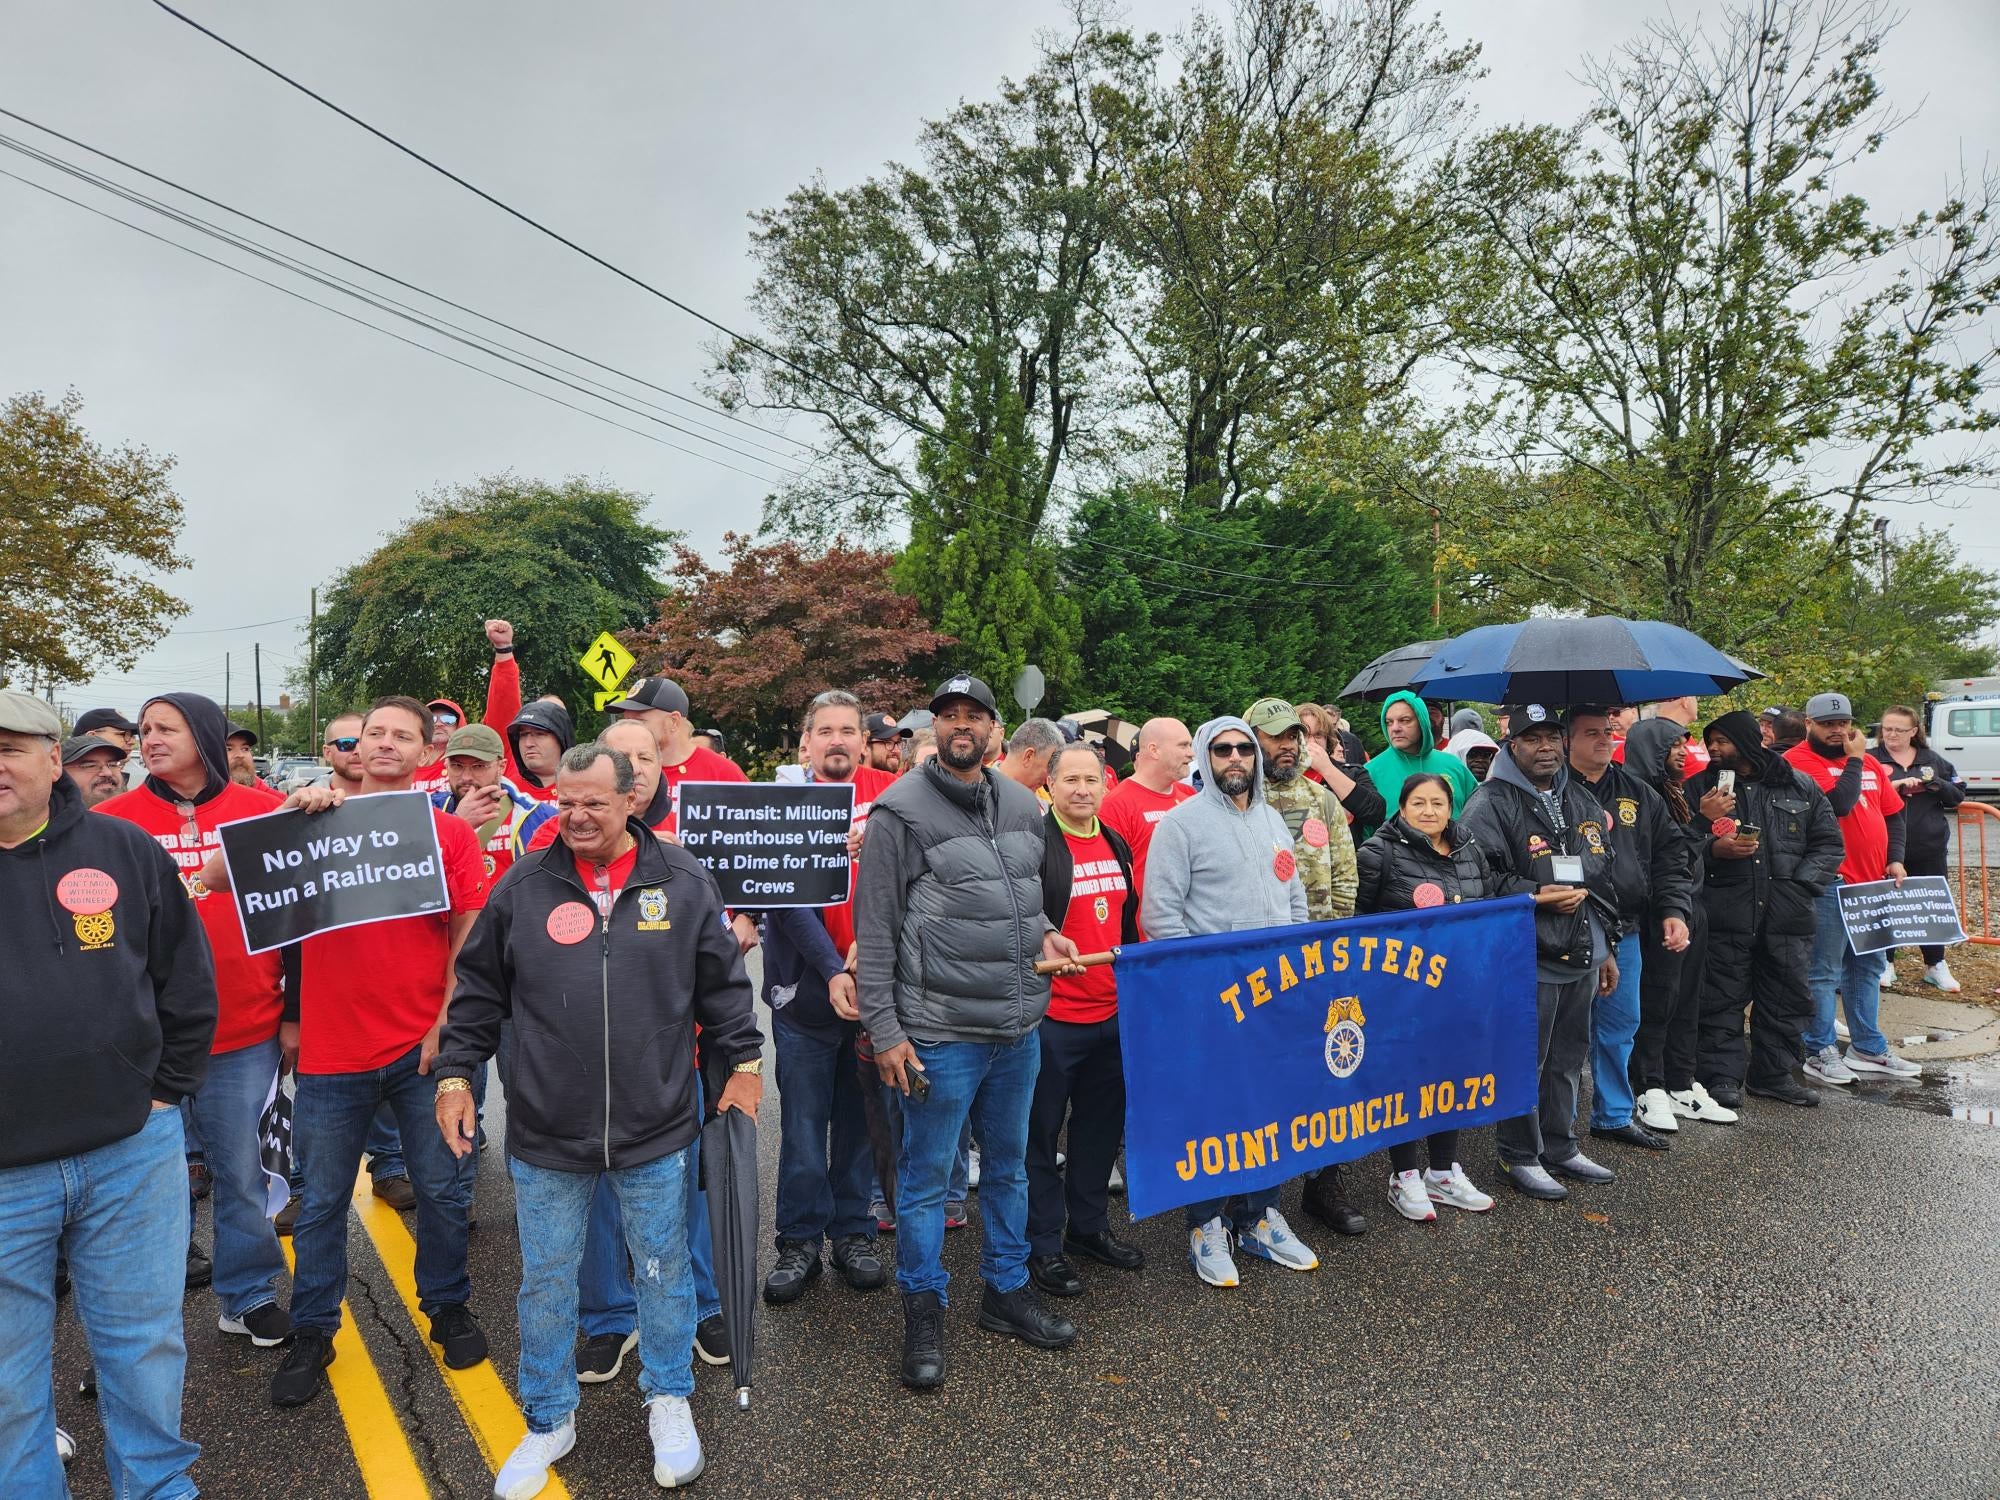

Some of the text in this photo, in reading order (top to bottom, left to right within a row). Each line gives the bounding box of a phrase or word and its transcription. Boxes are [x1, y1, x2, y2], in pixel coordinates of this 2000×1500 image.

[1831, 699, 1841, 711] B
[687, 805, 711, 820] NJ
[716, 805, 781, 820] Transit:
[786, 805, 848, 821] Millions
[680, 829, 848, 845] for Penthouse Views
[262, 830, 399, 873] No Way to
[699, 854, 848, 870] ot a Dime for Train
[244, 855, 435, 914] Run a Railroad
[742, 879, 795, 894] Crews
[1844, 888, 1946, 907] NJ Transit: Millions
[1843, 901, 1954, 921] for Penthouse Views
[1848, 914, 1957, 935] Not a Dime for Train
[1893, 928, 1927, 939] Crews
[1219, 936, 1448, 1024] TEAMSTERS
[1175, 1073, 1497, 1181] JOINT COUNCIL NO.73
